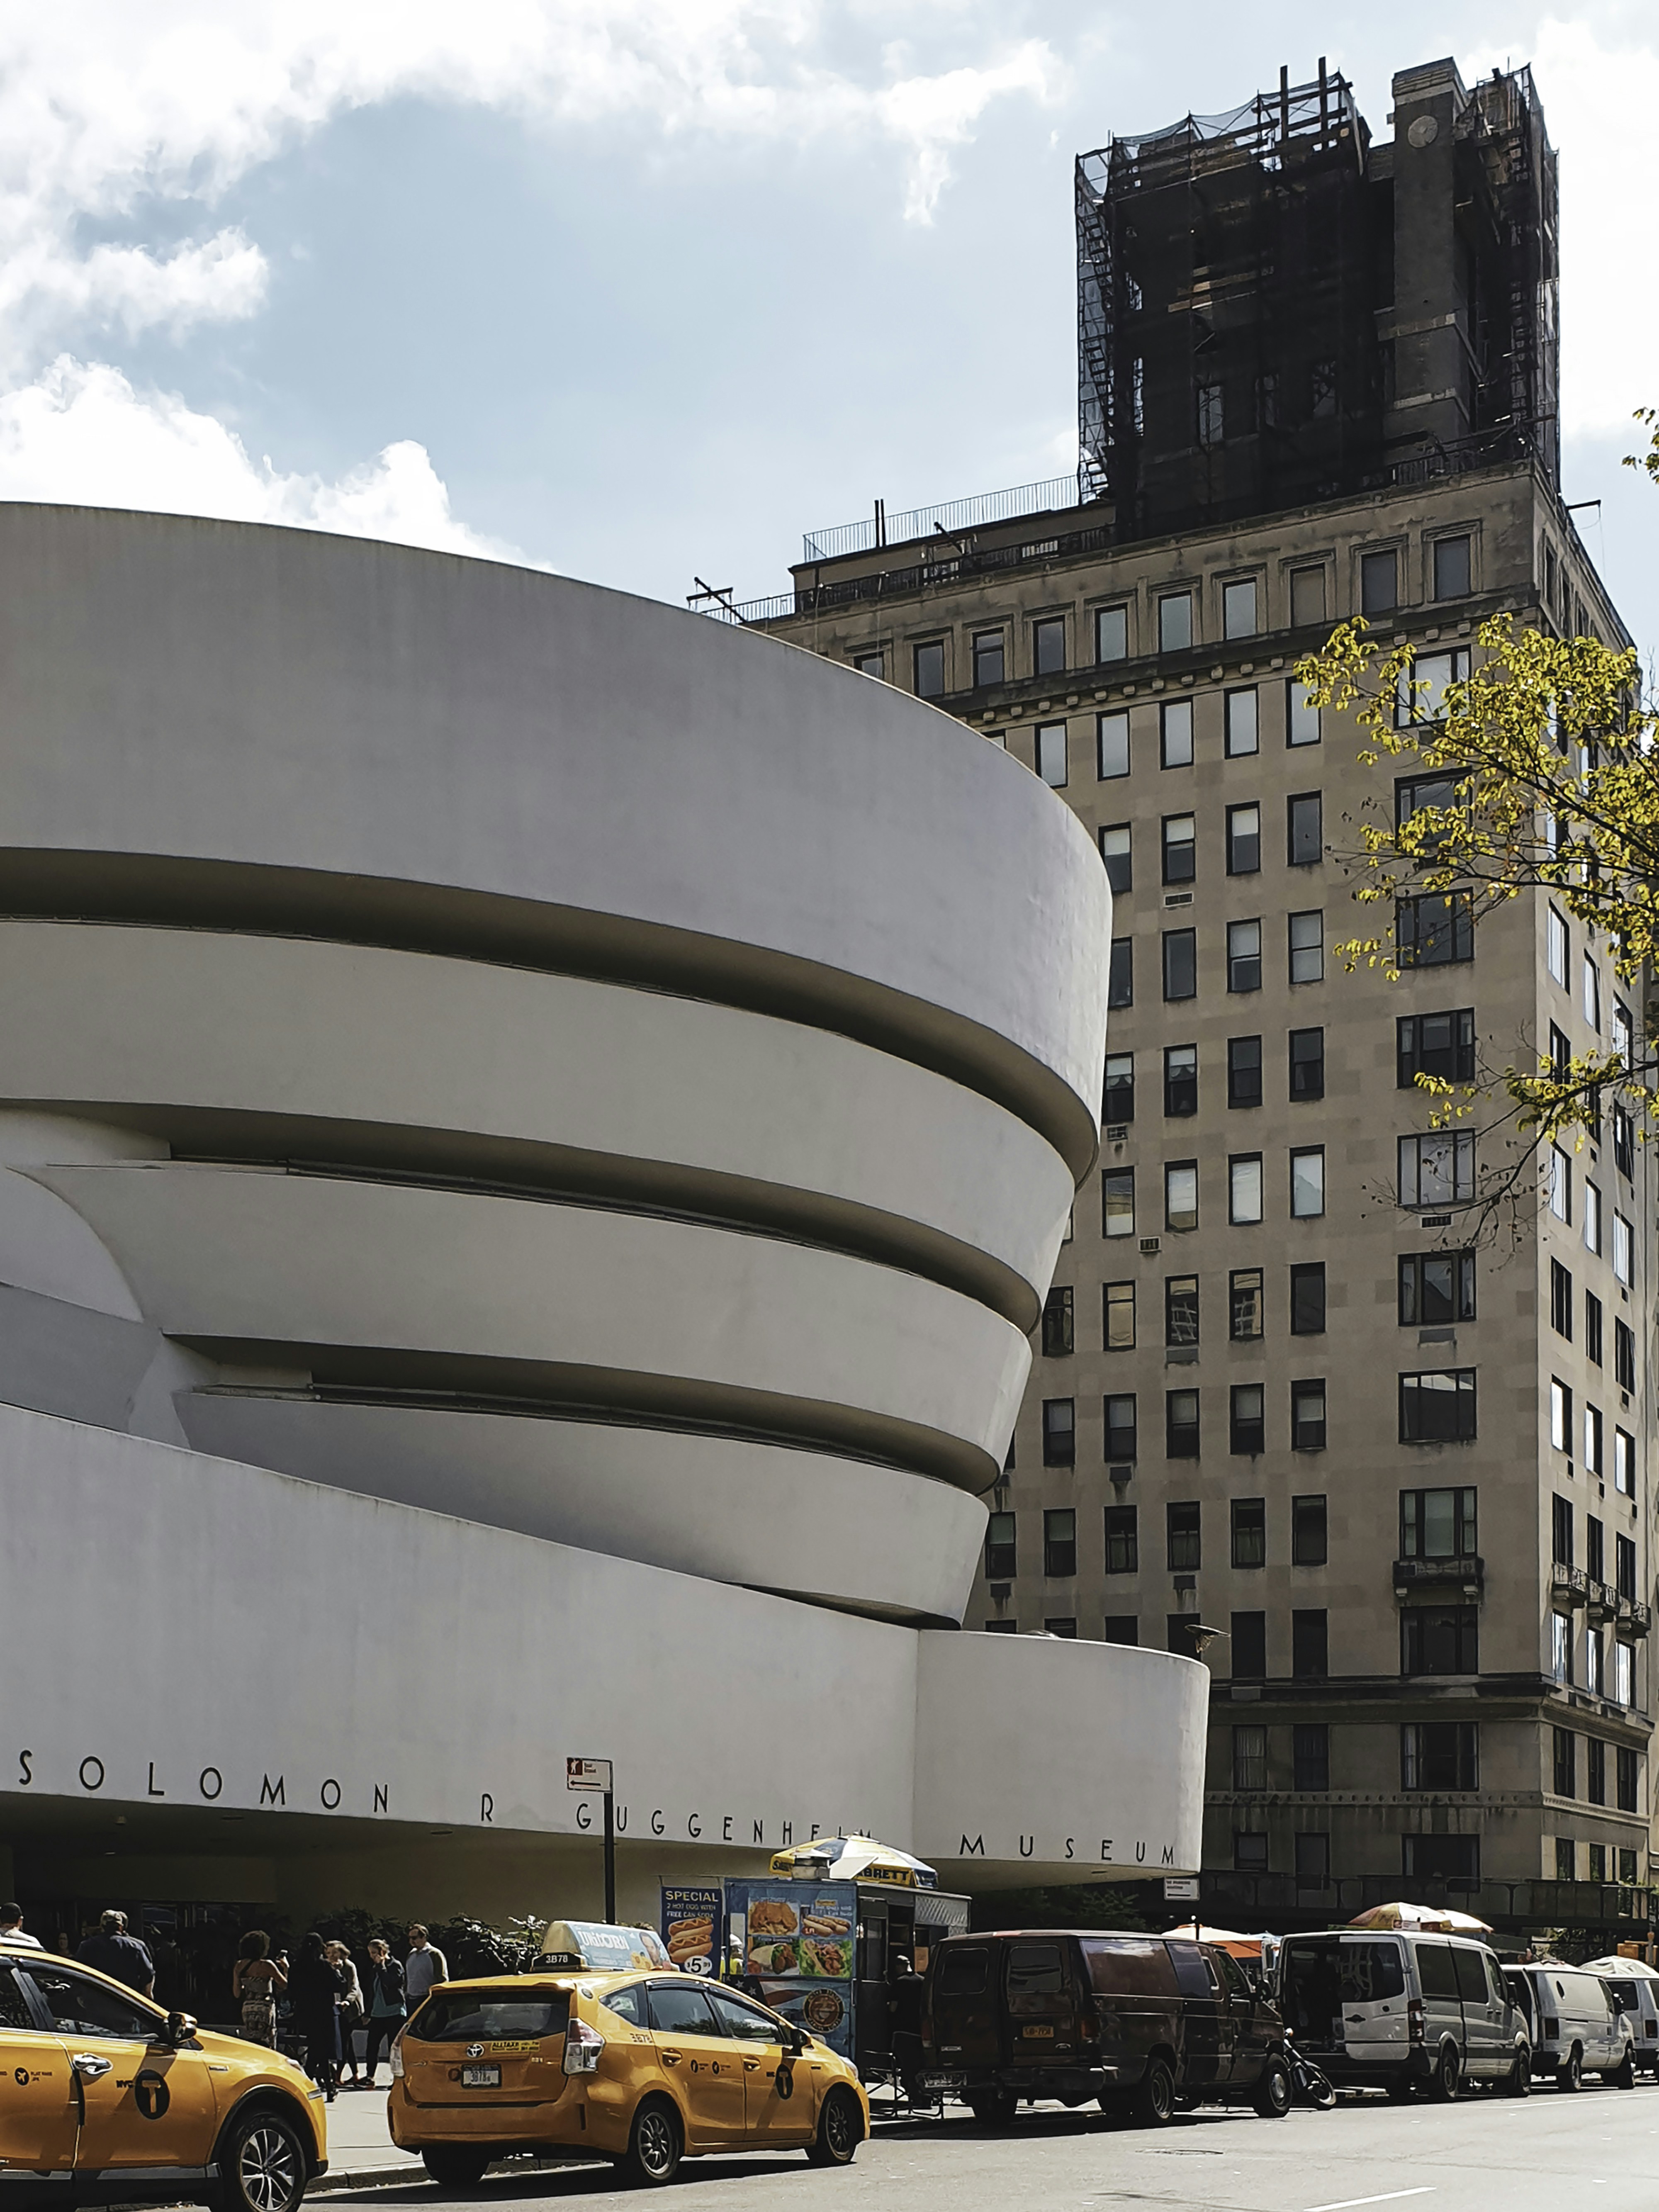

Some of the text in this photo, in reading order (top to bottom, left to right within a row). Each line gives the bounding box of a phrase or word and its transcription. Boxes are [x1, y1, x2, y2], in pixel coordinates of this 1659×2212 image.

[19, 1750, 388, 1813] SOLOMON
[481, 1793, 494, 1822] R
[959, 1834, 1174, 1865] MUSEUM
[665, 1891, 719, 1902] SPECIAL
[545, 1954, 568, 1964] 3B78
[116, 2080, 134, 2088] NYC
